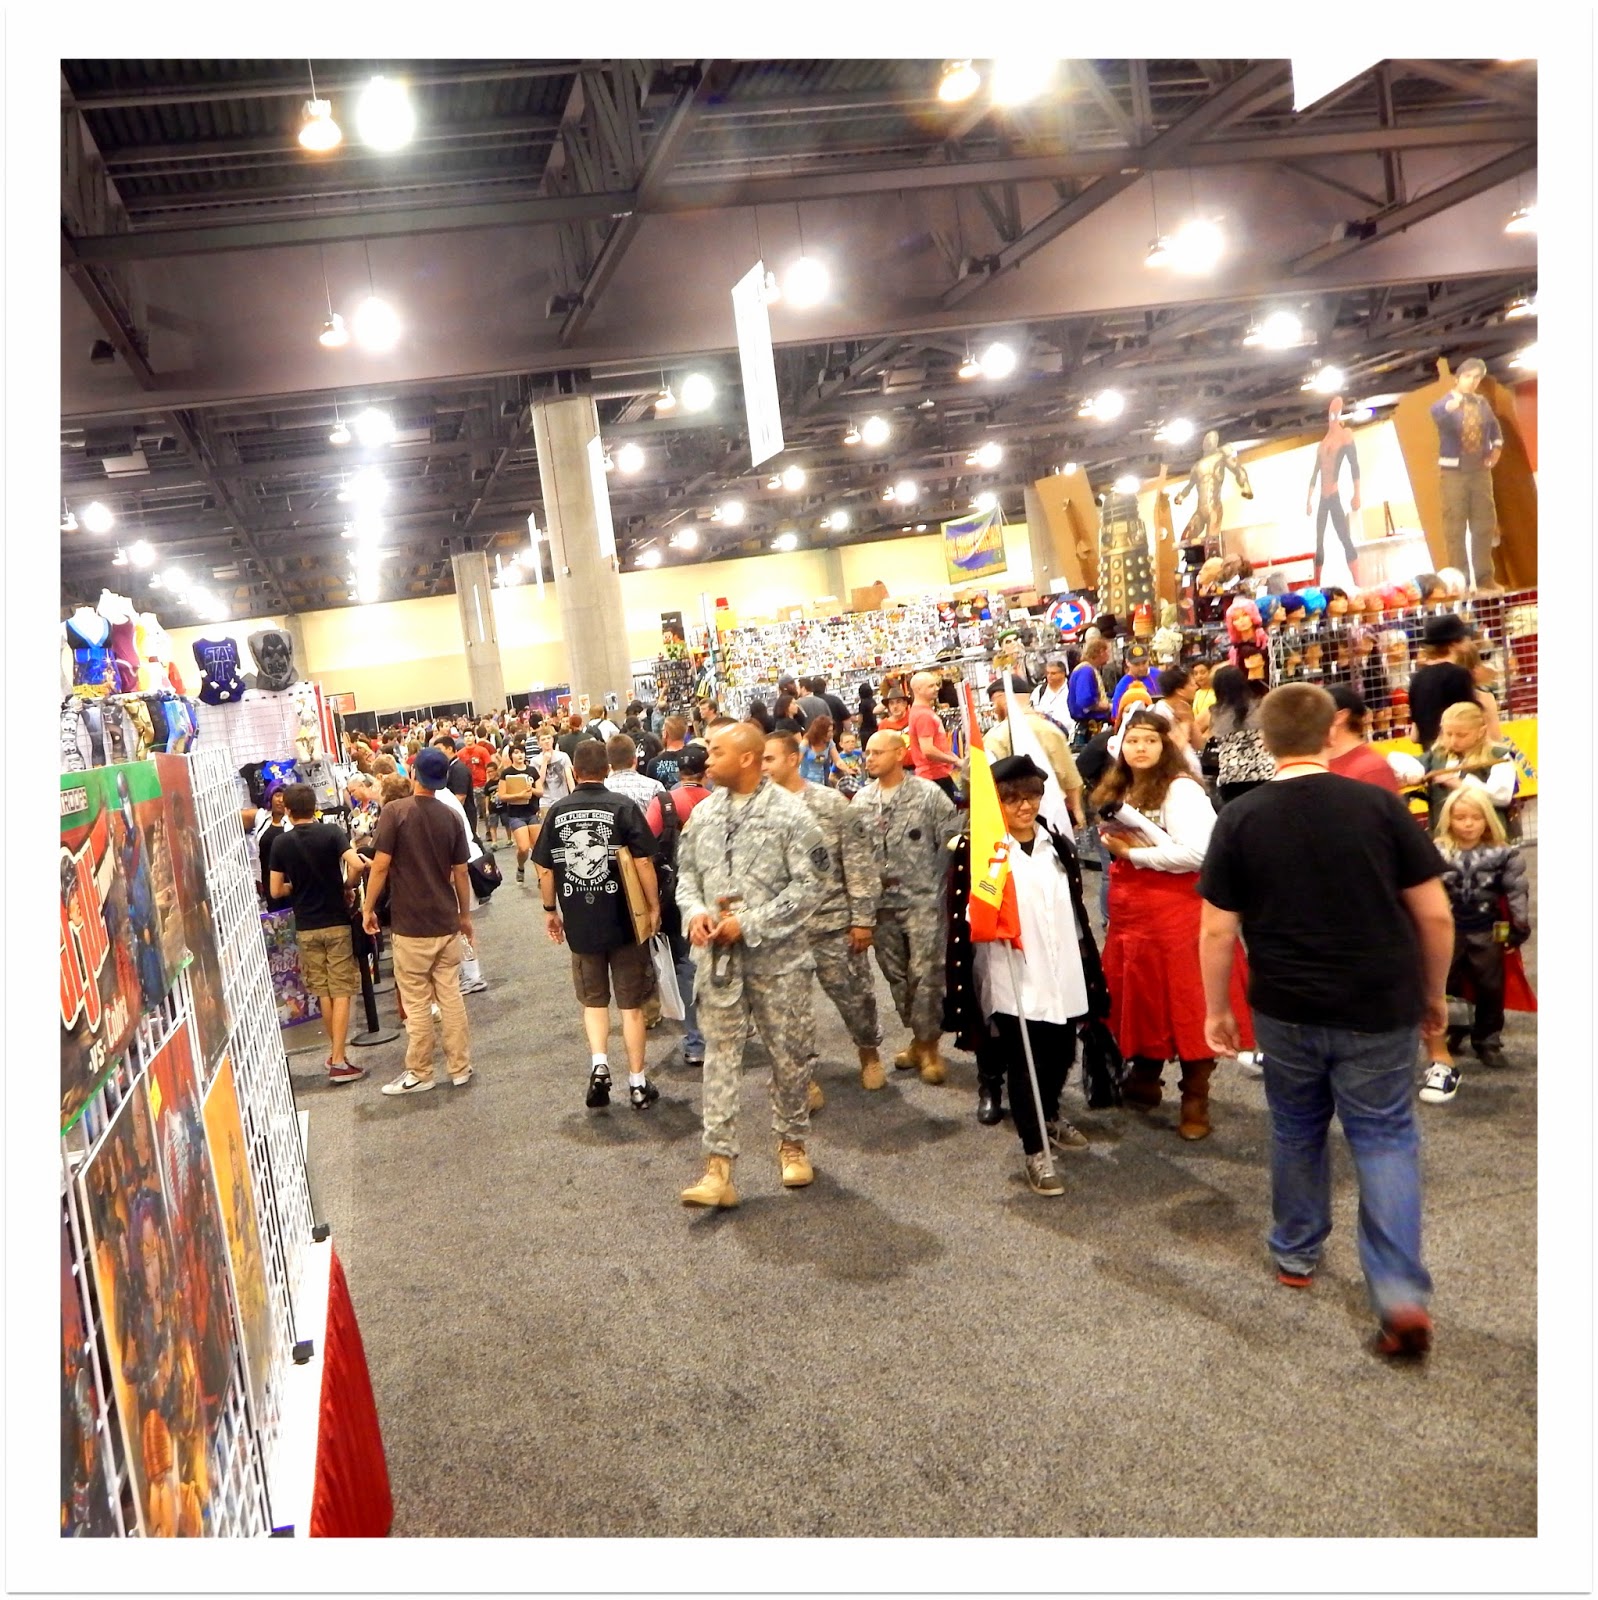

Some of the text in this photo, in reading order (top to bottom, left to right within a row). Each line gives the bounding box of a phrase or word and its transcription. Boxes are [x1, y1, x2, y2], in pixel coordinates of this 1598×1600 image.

[205, 646, 235, 662] STAR
[569, 812, 589, 820] FLIGHT
[592, 812, 614, 822] SCHOOL
[565, 869, 611, 887] ROYAL FLUSH
[606, 883, 616, 891] 33
